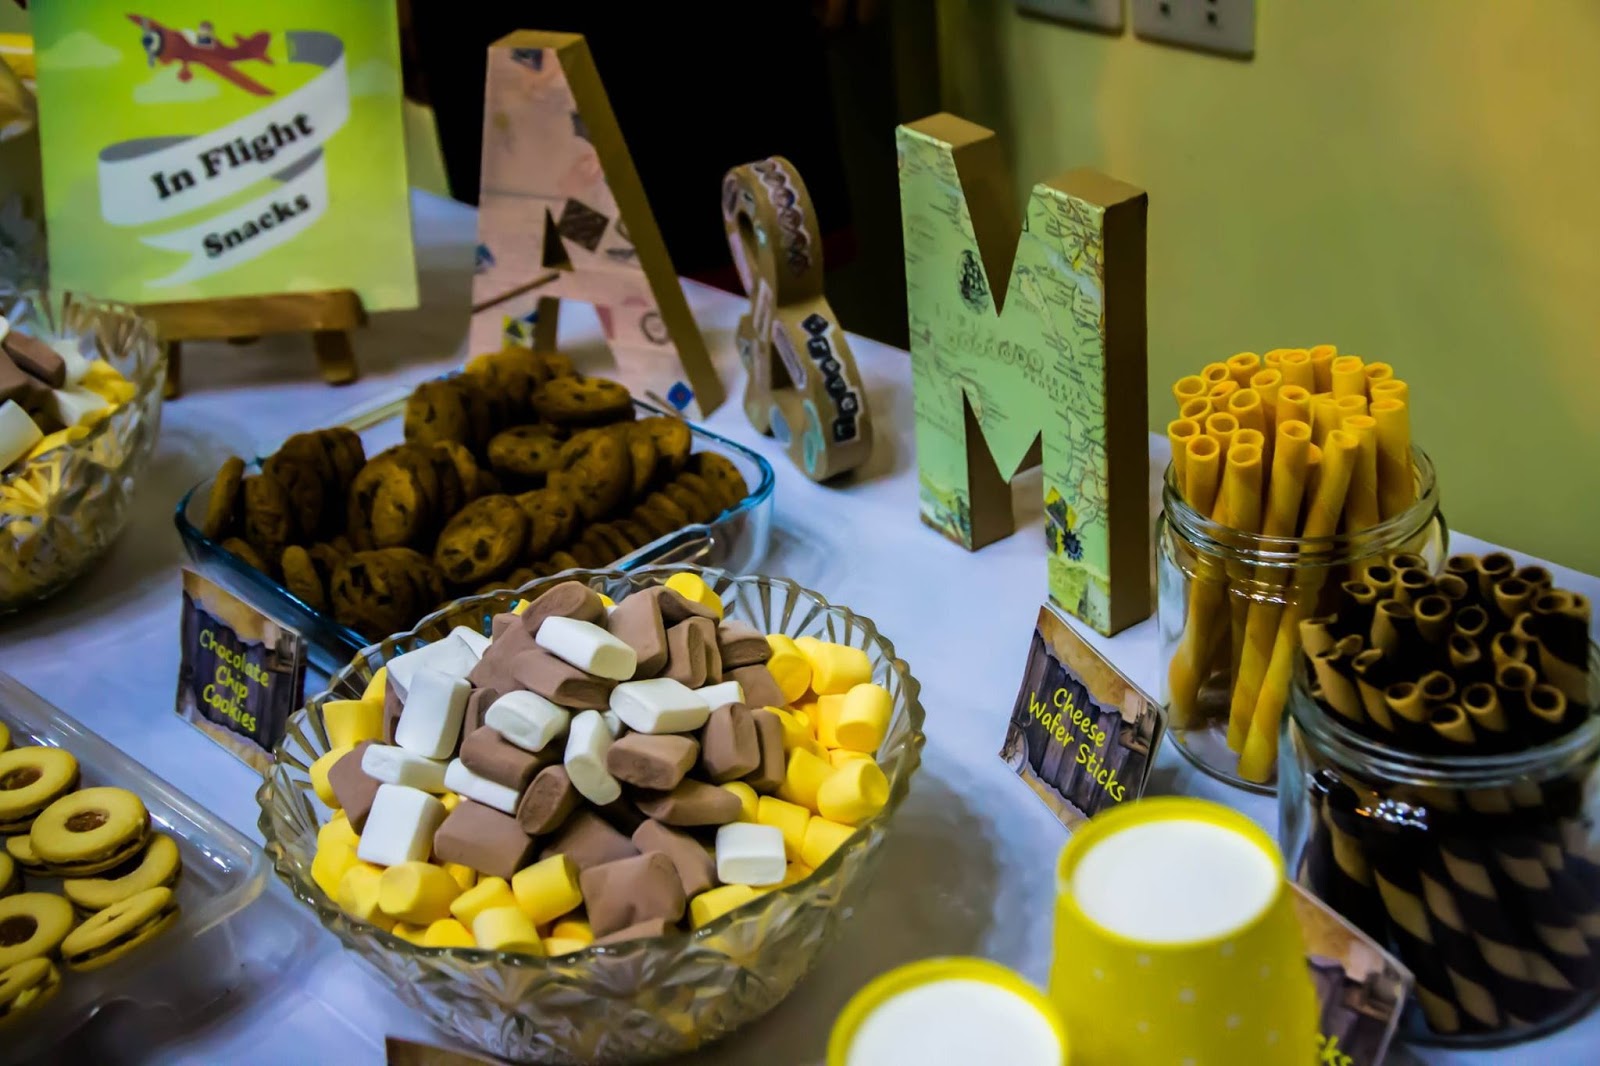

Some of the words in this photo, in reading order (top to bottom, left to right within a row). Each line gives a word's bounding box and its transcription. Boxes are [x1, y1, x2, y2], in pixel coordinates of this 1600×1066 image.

[152, 171, 196, 200] In
[198, 113, 313, 179] Flight
[203, 195, 310, 258] Snacks
[468, 30, 726, 420] A
[896, 112, 1149, 638] M
[200, 629, 269, 687] Chocolate
[216, 665, 249, 704] Chip
[203, 684, 256, 732] Cookies
[1053, 687, 1105, 748] Cheese
[1029, 692, 1075, 747] Wafer
[1076, 743, 1125, 802] Sticks
